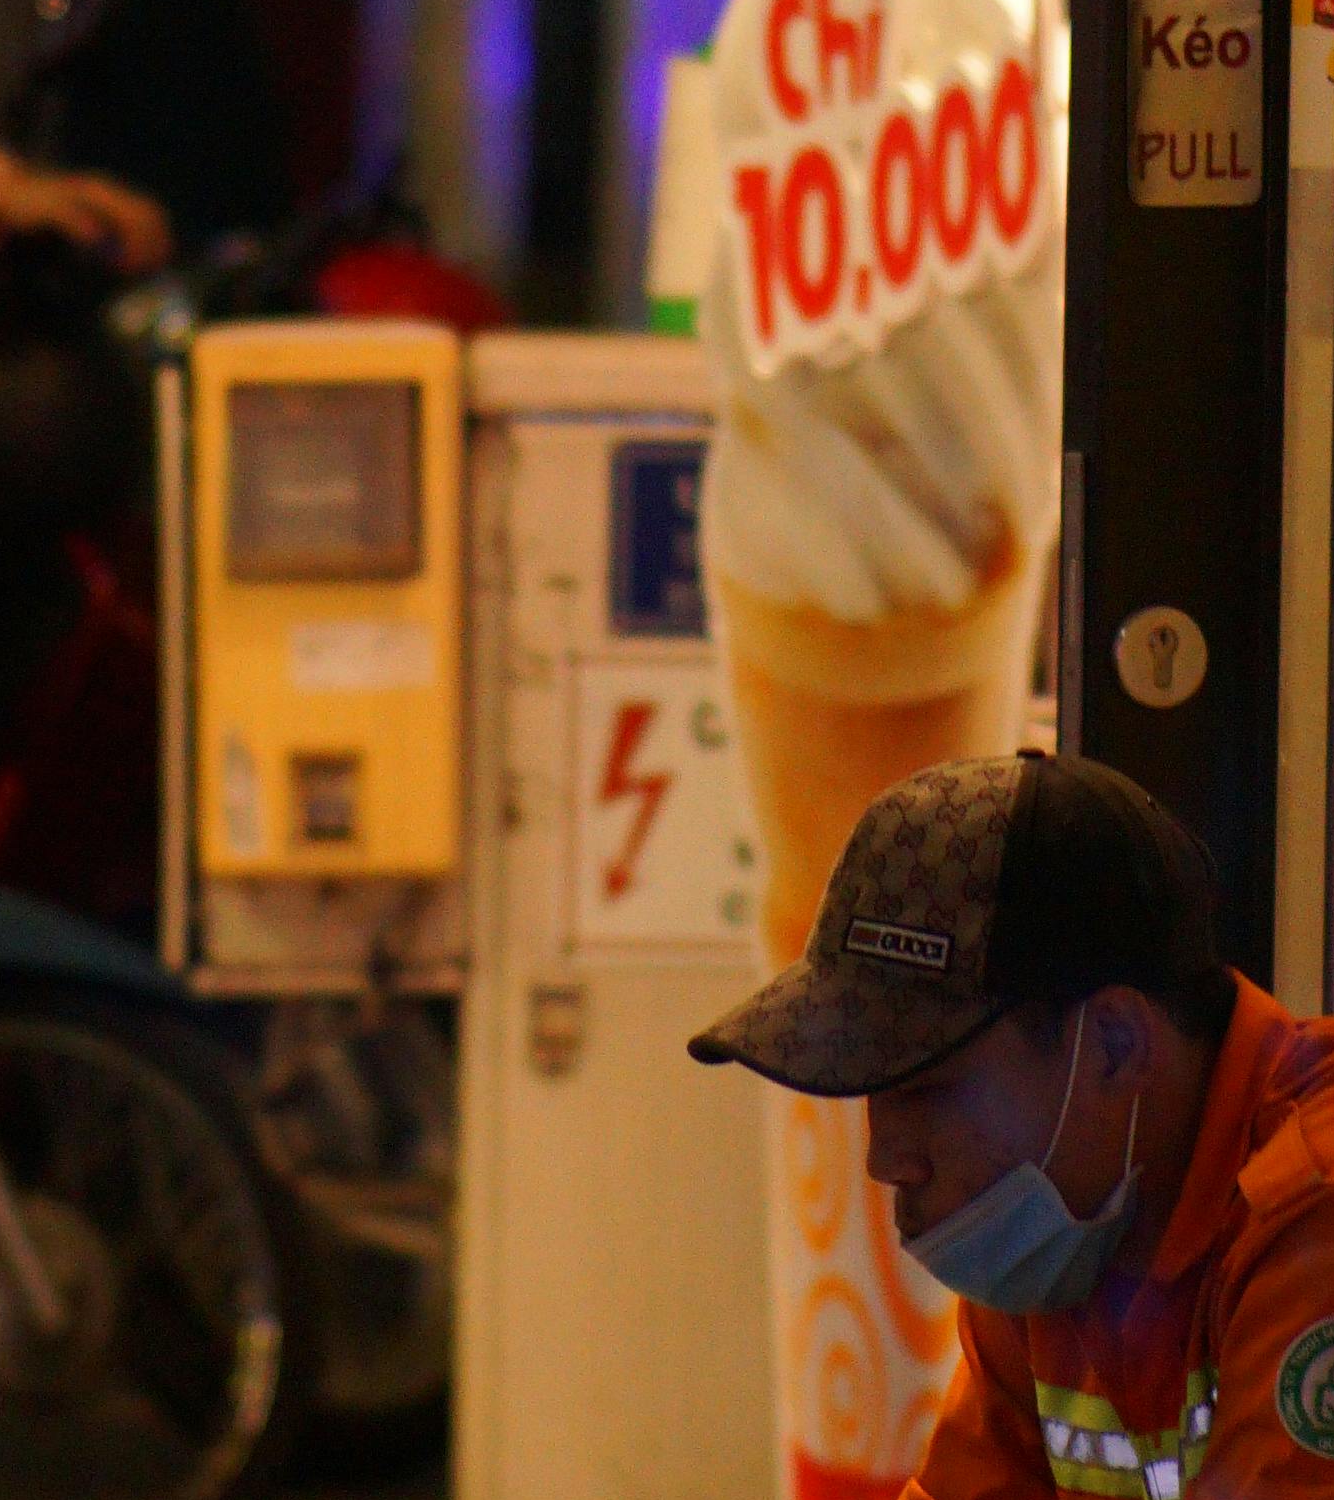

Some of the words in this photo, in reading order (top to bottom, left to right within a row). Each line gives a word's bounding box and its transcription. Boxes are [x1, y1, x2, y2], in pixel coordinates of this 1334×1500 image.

[1141, 14, 1252, 70] Kéo
[1136, 131, 1253, 181] PULL
[734, 59, 1038, 345] 10.000
